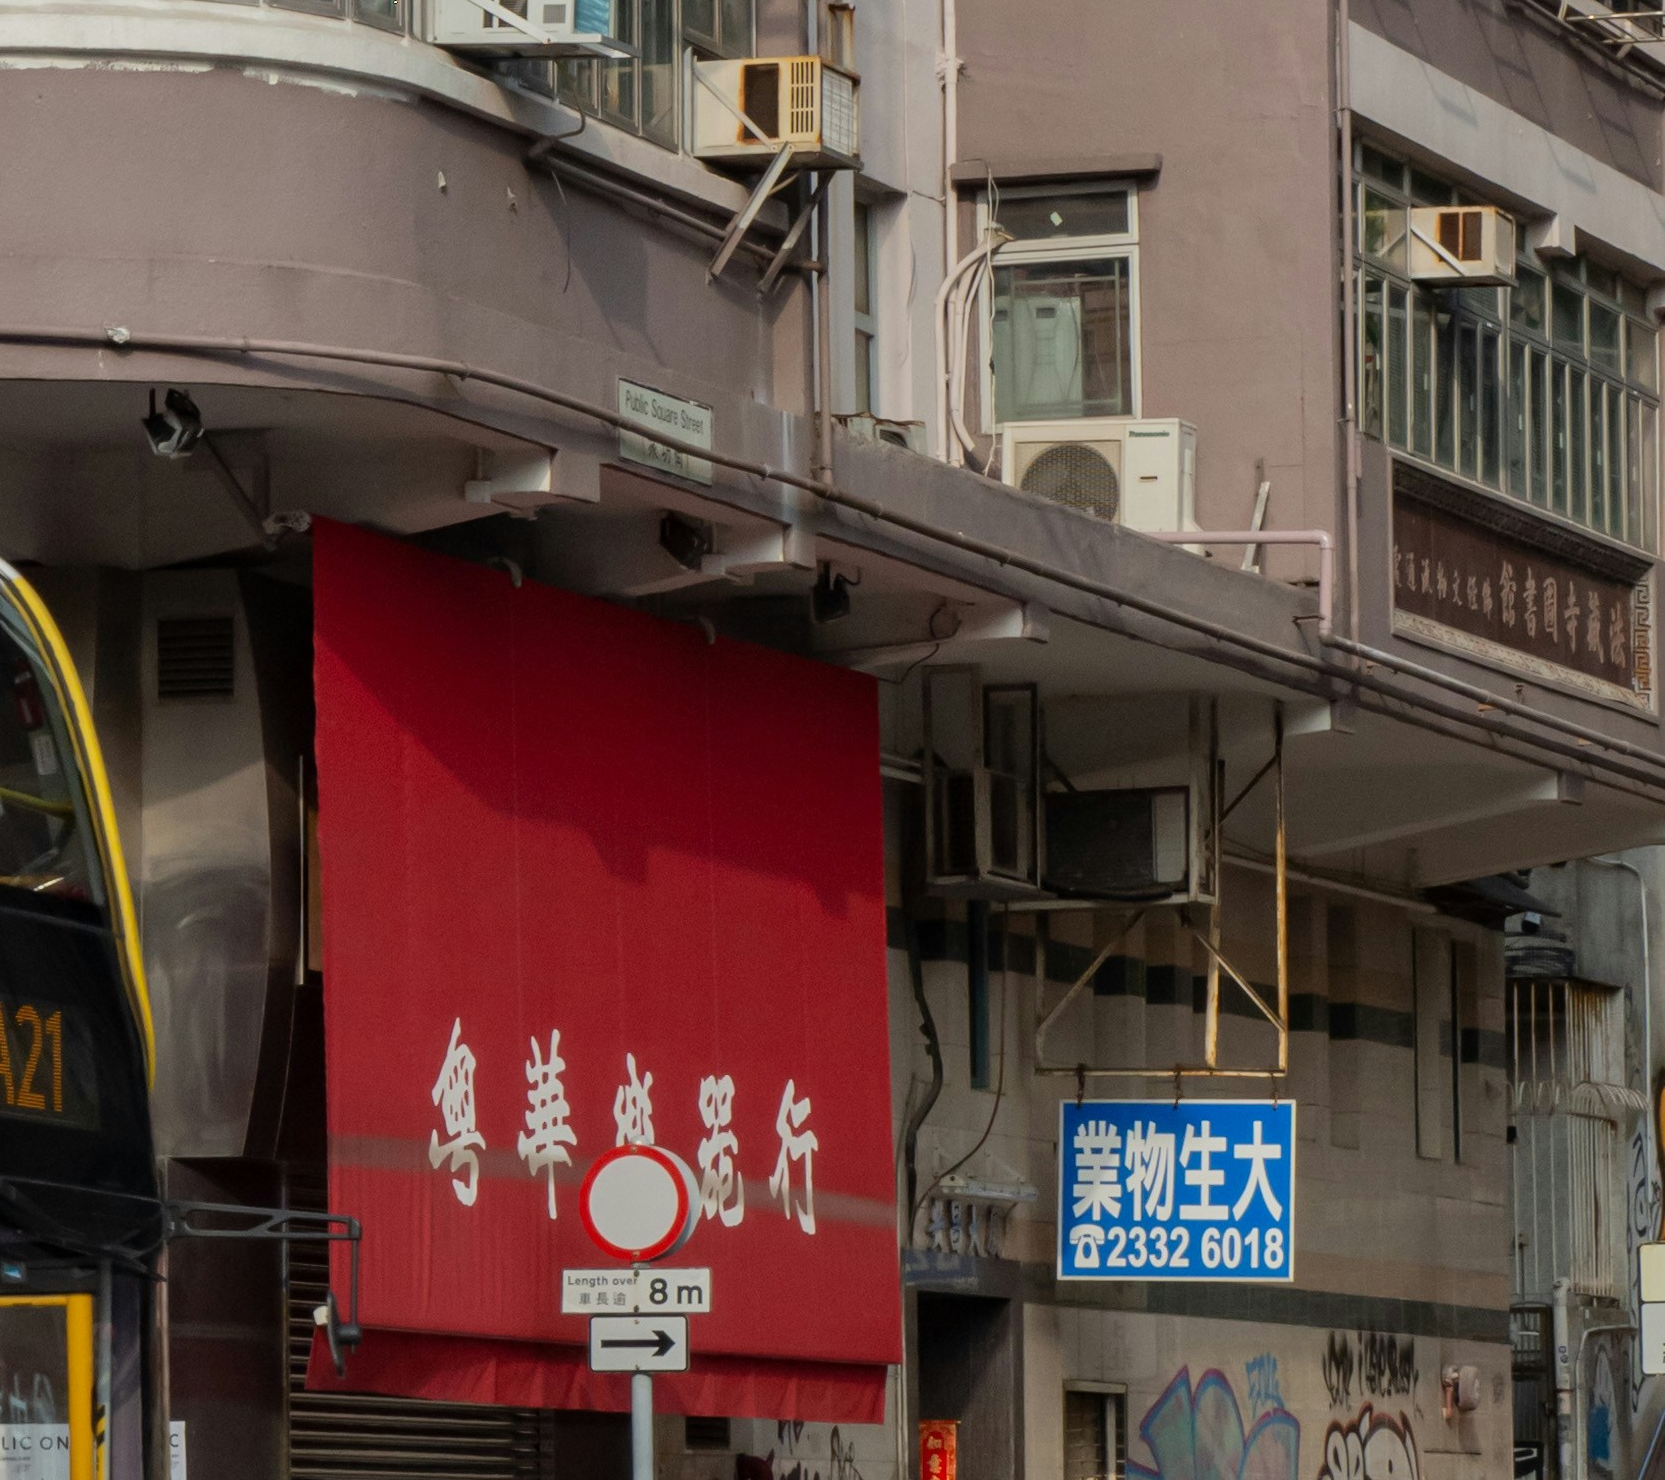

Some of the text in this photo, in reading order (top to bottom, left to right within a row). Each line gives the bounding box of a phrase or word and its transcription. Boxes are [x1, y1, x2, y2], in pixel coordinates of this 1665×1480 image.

[624, 389, 704, 435] Public Square Street
[1106, 1226, 1285, 1269] 2332 6018
[567, 1275, 638, 1288] Length over
[649, 1277, 703, 1305] 8 m
[578, 1292, 627, 1306] 車長逾
